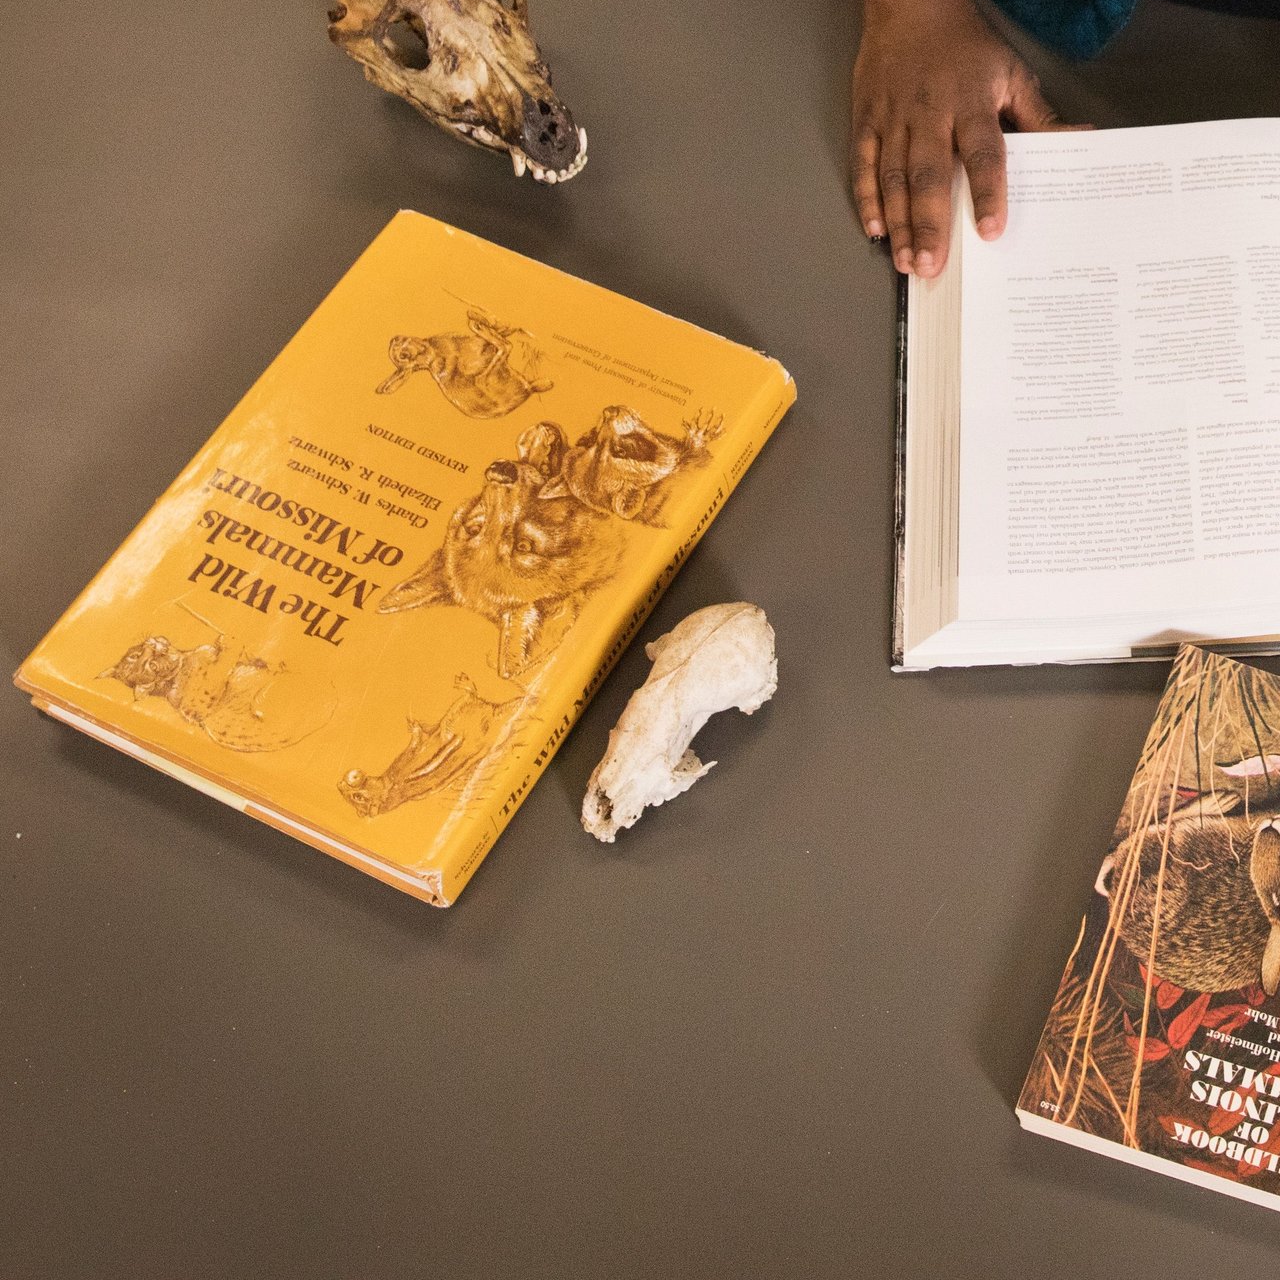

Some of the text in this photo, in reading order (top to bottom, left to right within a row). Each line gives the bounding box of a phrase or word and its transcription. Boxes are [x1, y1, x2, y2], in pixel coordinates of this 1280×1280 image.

[286, 434, 443, 511] Elizabeth R. Schwartz
[364, 422, 471, 476] REVISED EDITION
[202, 465, 404, 569] of Missouri
[284, 458, 430, 530] Charles W. Schwartz
[194, 505, 381, 610] Mammals
[186, 551, 349, 647] The Wild
[498, 773, 532, 816] The
[532, 713, 571, 767] Wild
[664, 486, 725, 576] Missouri
[1204, 1026, 1280, 1062] Hoffmeister
[1243, 1006, 1280, 1029] Mohr
[1232, 1118, 1271, 1146] OF
